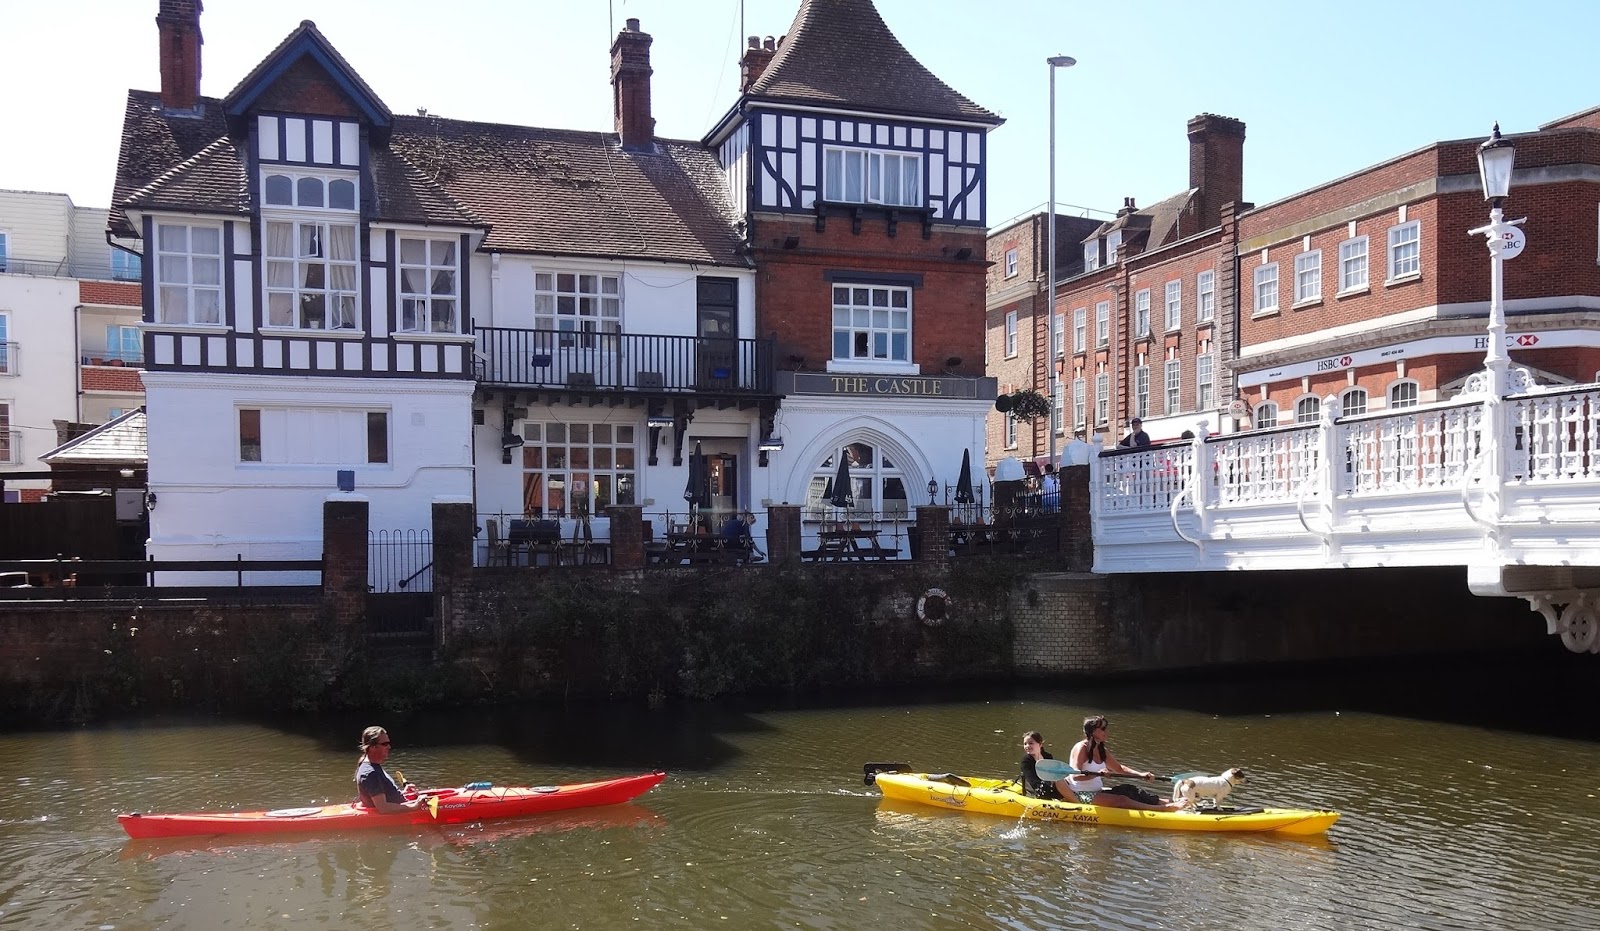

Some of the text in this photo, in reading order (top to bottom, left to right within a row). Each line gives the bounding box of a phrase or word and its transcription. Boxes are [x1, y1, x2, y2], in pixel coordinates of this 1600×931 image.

[1502, 241, 1521, 249] BC
[1474, 335, 1514, 349] HC
[1317, 358, 1339, 371] HSBC
[831, 377, 942, 395] THE CASTLE
[1032, 810, 1099, 823] OCEAN KAYAK
